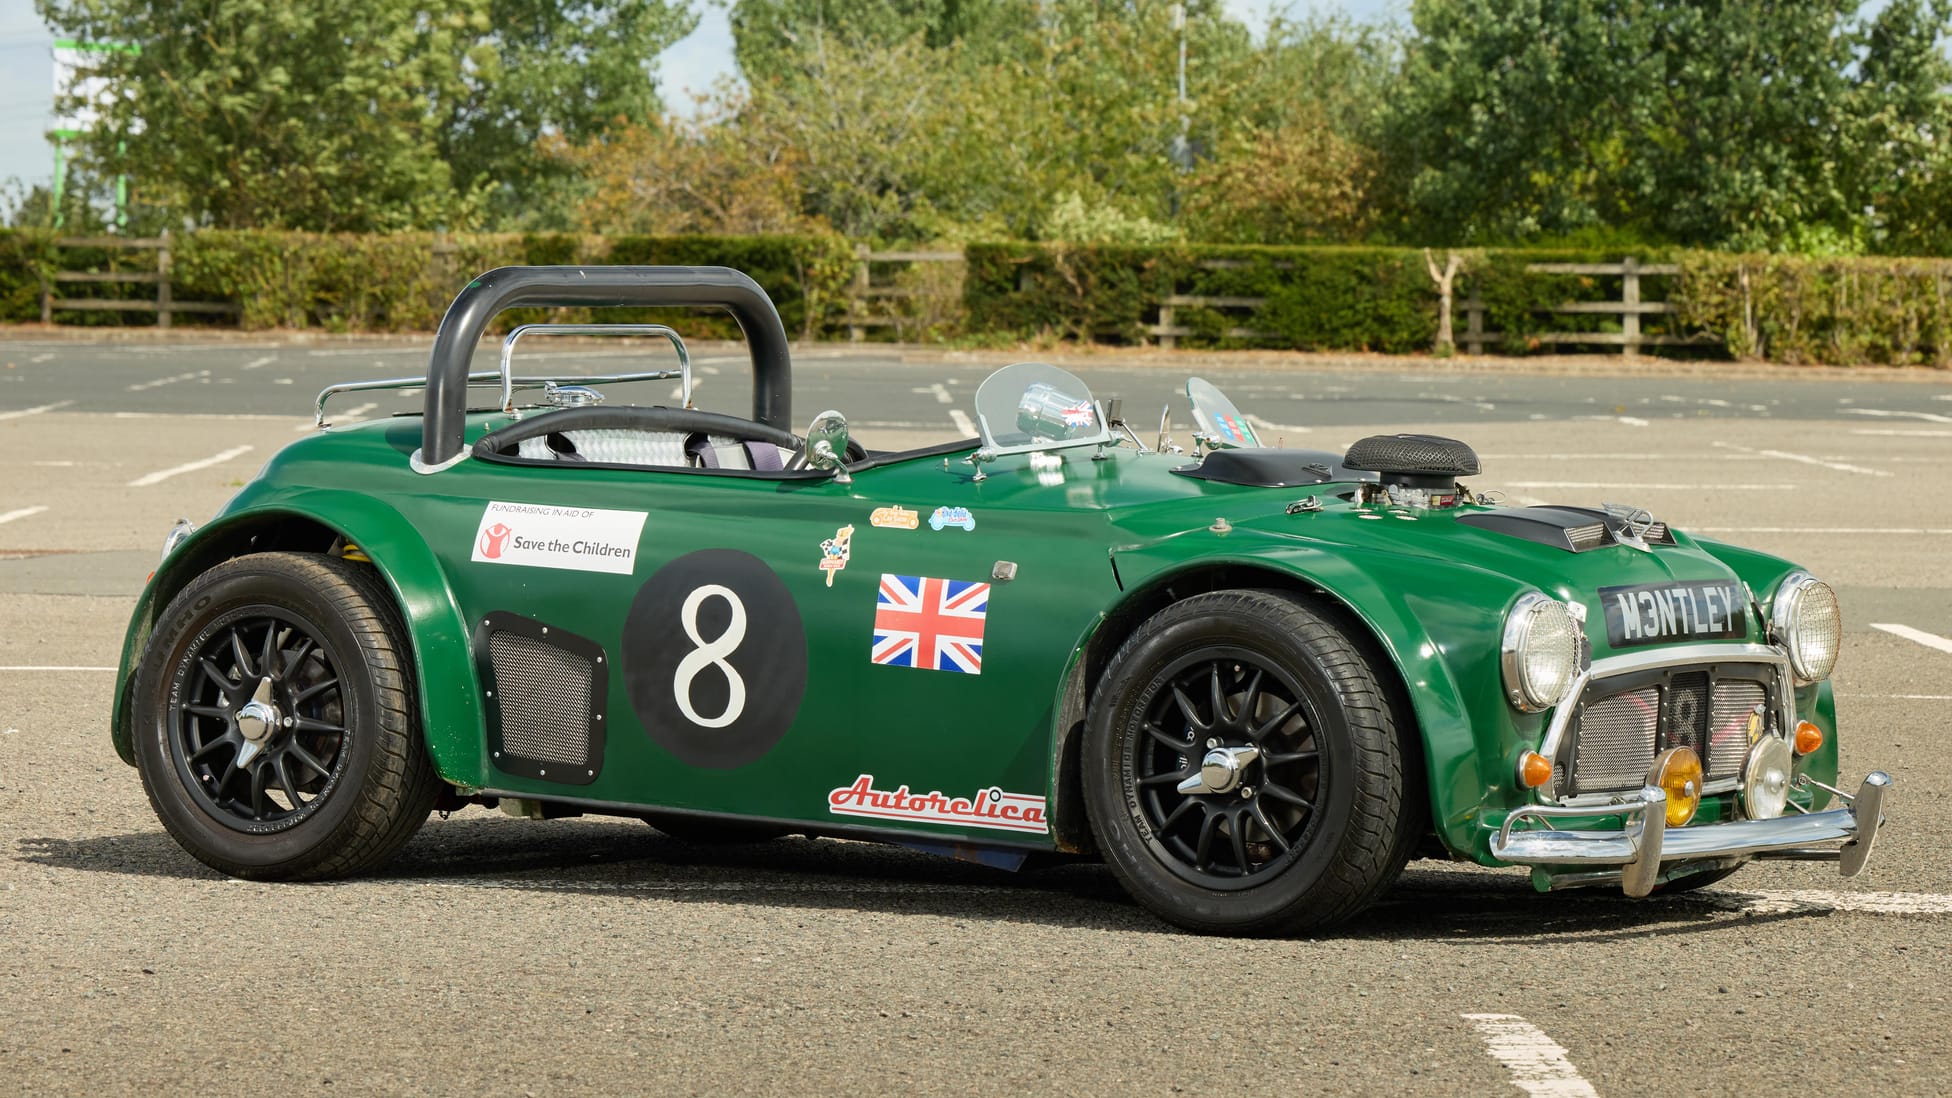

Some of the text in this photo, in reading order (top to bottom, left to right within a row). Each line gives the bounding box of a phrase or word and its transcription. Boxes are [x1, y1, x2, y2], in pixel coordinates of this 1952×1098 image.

[491, 503, 595, 519] FUNDRAISING IN AID OF
[513, 536, 631, 558] Save the Children
[1617, 587, 1733, 639] M3NTLEY
[673, 584, 747, 728] 8
[169, 682, 181, 711] TEAM
[830, 776, 1047, 823] Autorelica
[1134, 814, 1153, 844] TEAM
